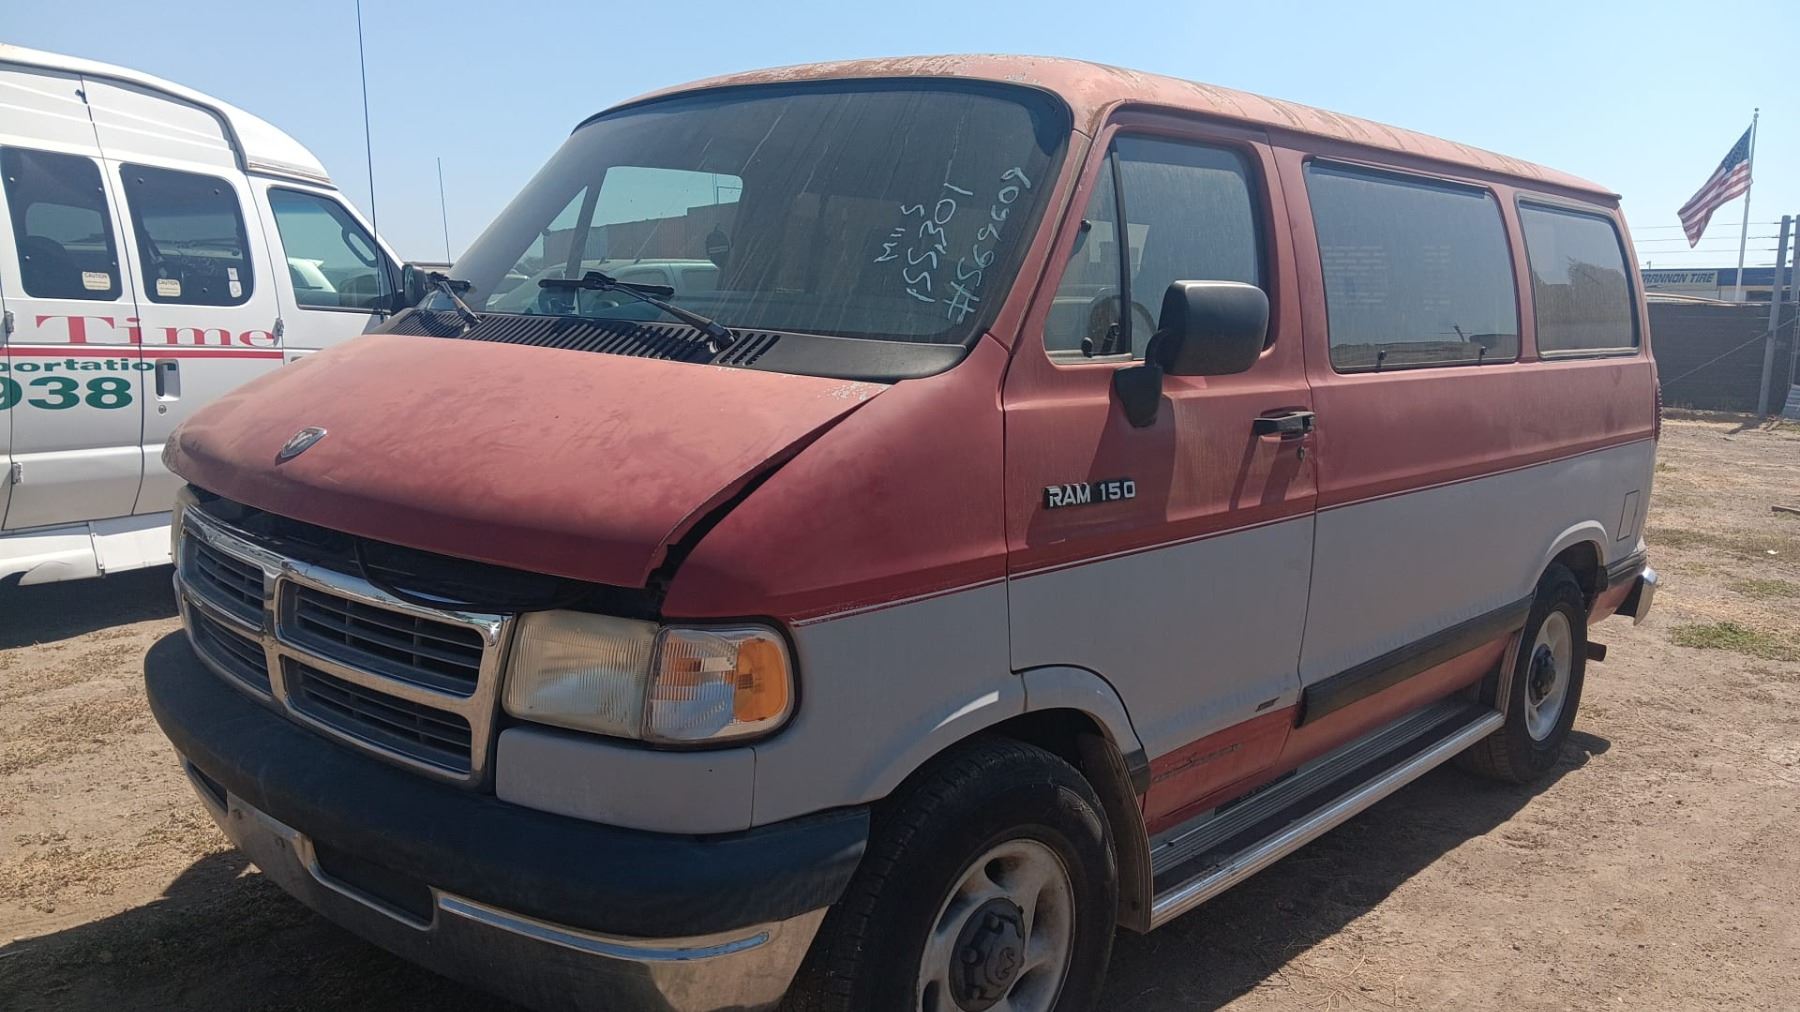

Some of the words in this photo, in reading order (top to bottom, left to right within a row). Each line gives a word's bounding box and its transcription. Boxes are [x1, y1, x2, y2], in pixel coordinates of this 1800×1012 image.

[1642, 272, 1688, 284] RANNON
[1689, 272, 1716, 283] TIRE
[35, 315, 276, 347] Time
[1046, 481, 1091, 508] RAM
[1099, 480, 1137, 502] 150
